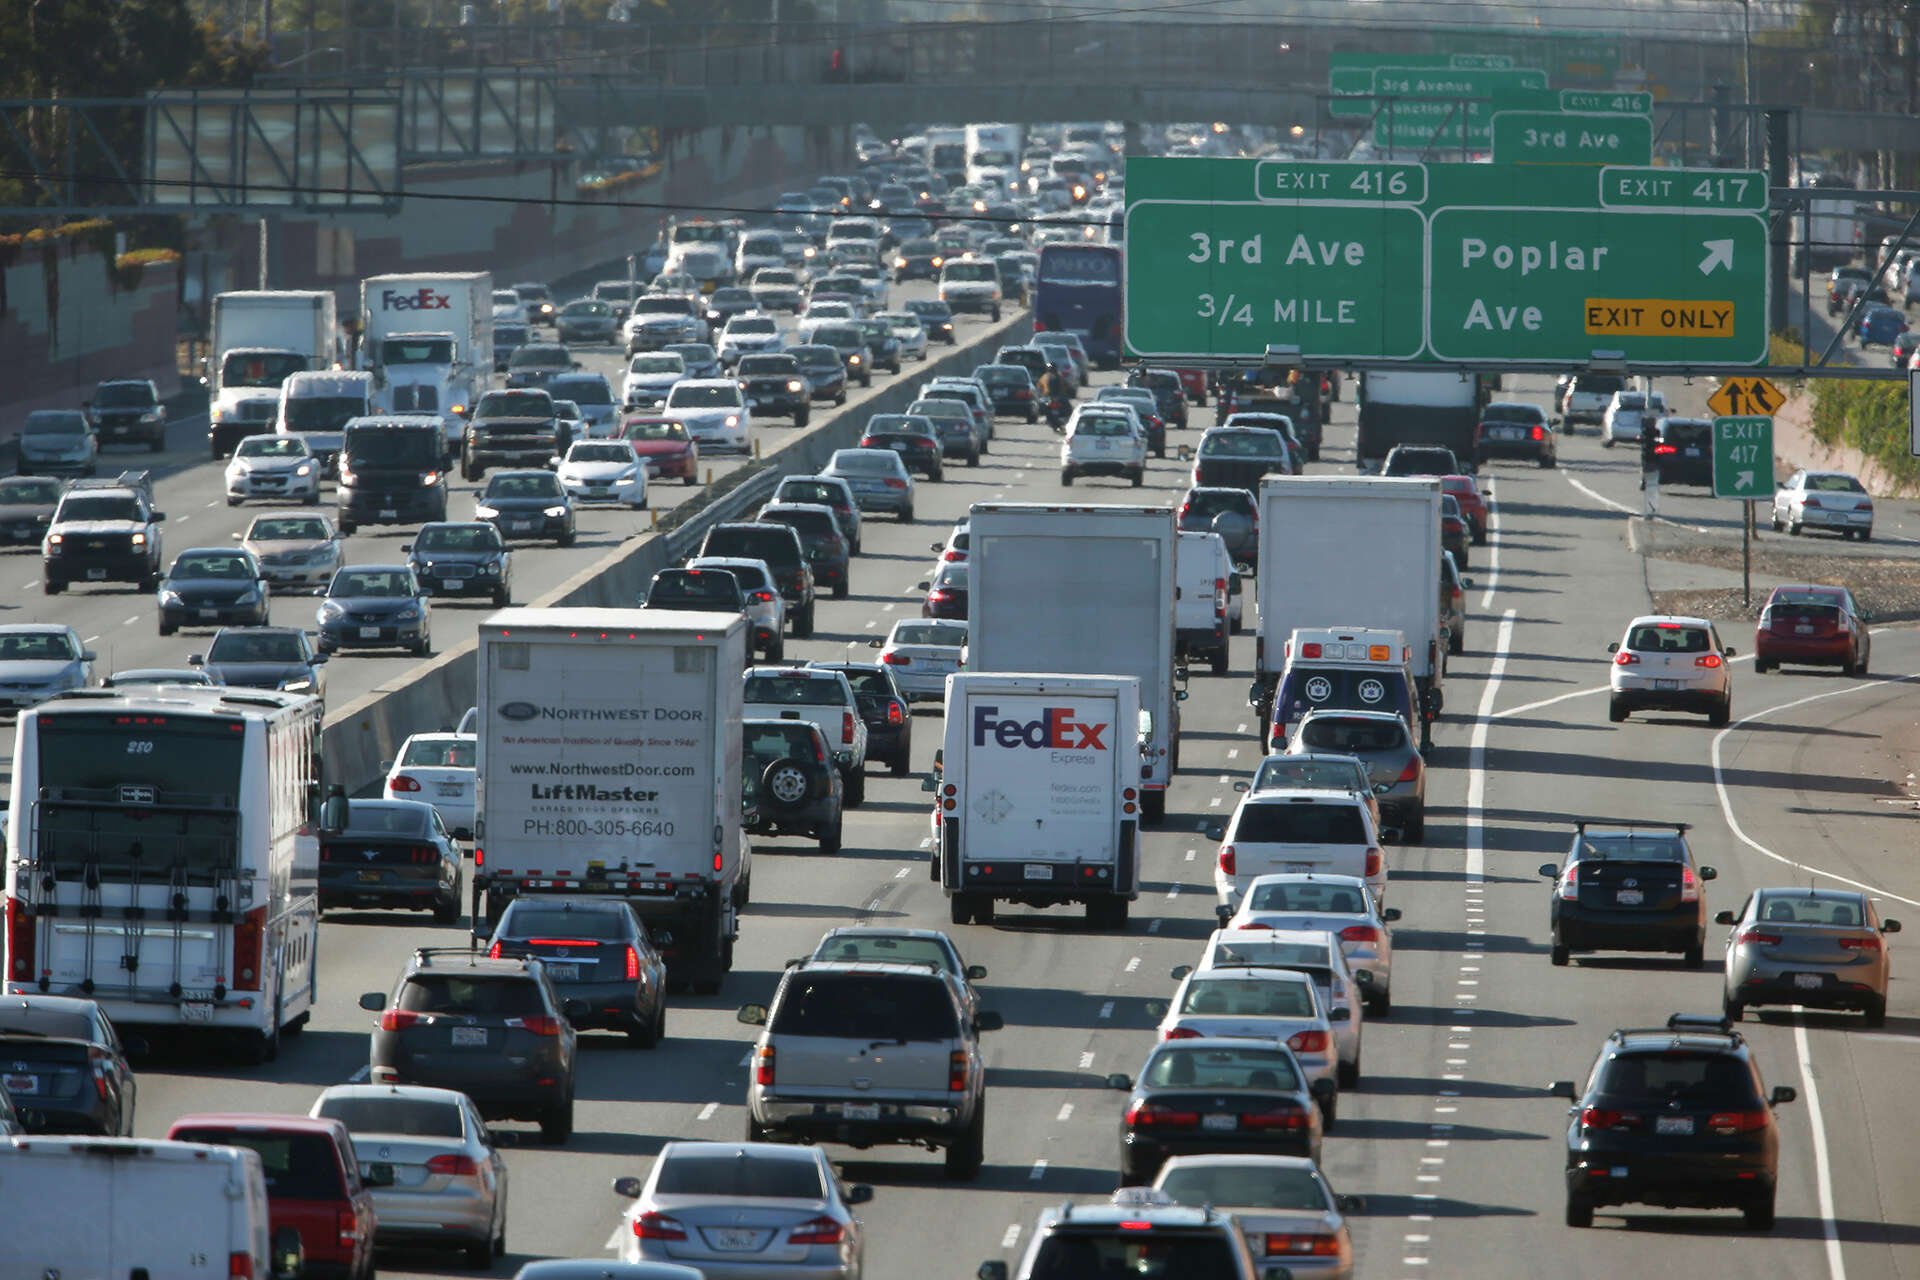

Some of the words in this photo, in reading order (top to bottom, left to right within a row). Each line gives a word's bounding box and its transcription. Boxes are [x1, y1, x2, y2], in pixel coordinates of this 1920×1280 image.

[1383, 79, 1408, 91] 3rd
[1416, 79, 1472, 91] Avenue
[1571, 96, 1600, 106] EXIT
[1611, 96, 1642, 110] 416
[1524, 129, 1566, 148] 3rd
[1579, 130, 1620, 148] Ave
[1276, 172, 1330, 191] EXIT
[1350, 171, 1408, 195] 416
[1619, 179, 1672, 198] EXIT
[1692, 178, 1750, 203] 417
[1188, 232, 1263, 266] 3rd
[1286, 234, 1366, 267] Ave
[1463, 238, 1609, 276] Poplar
[382, 288, 452, 311] FedEx
[1196, 293, 1255, 327] 3/4
[1273, 299, 1357, 324] MILE
[1463, 298, 1543, 331] Ave
[1587, 306, 1645, 329] EXIT
[1660, 308, 1734, 331] ONLY
[1721, 423, 1766, 440] EXIT
[1729, 445, 1759, 464] 417
[974, 706, 1108, 750] FedEx
[511, 762, 695, 777] www.NorthwestDoor.com
[1051, 752, 1096, 766] Express
[531, 783, 660, 802] LiftMaster
[524, 819, 675, 837] PH:800-305-6640
